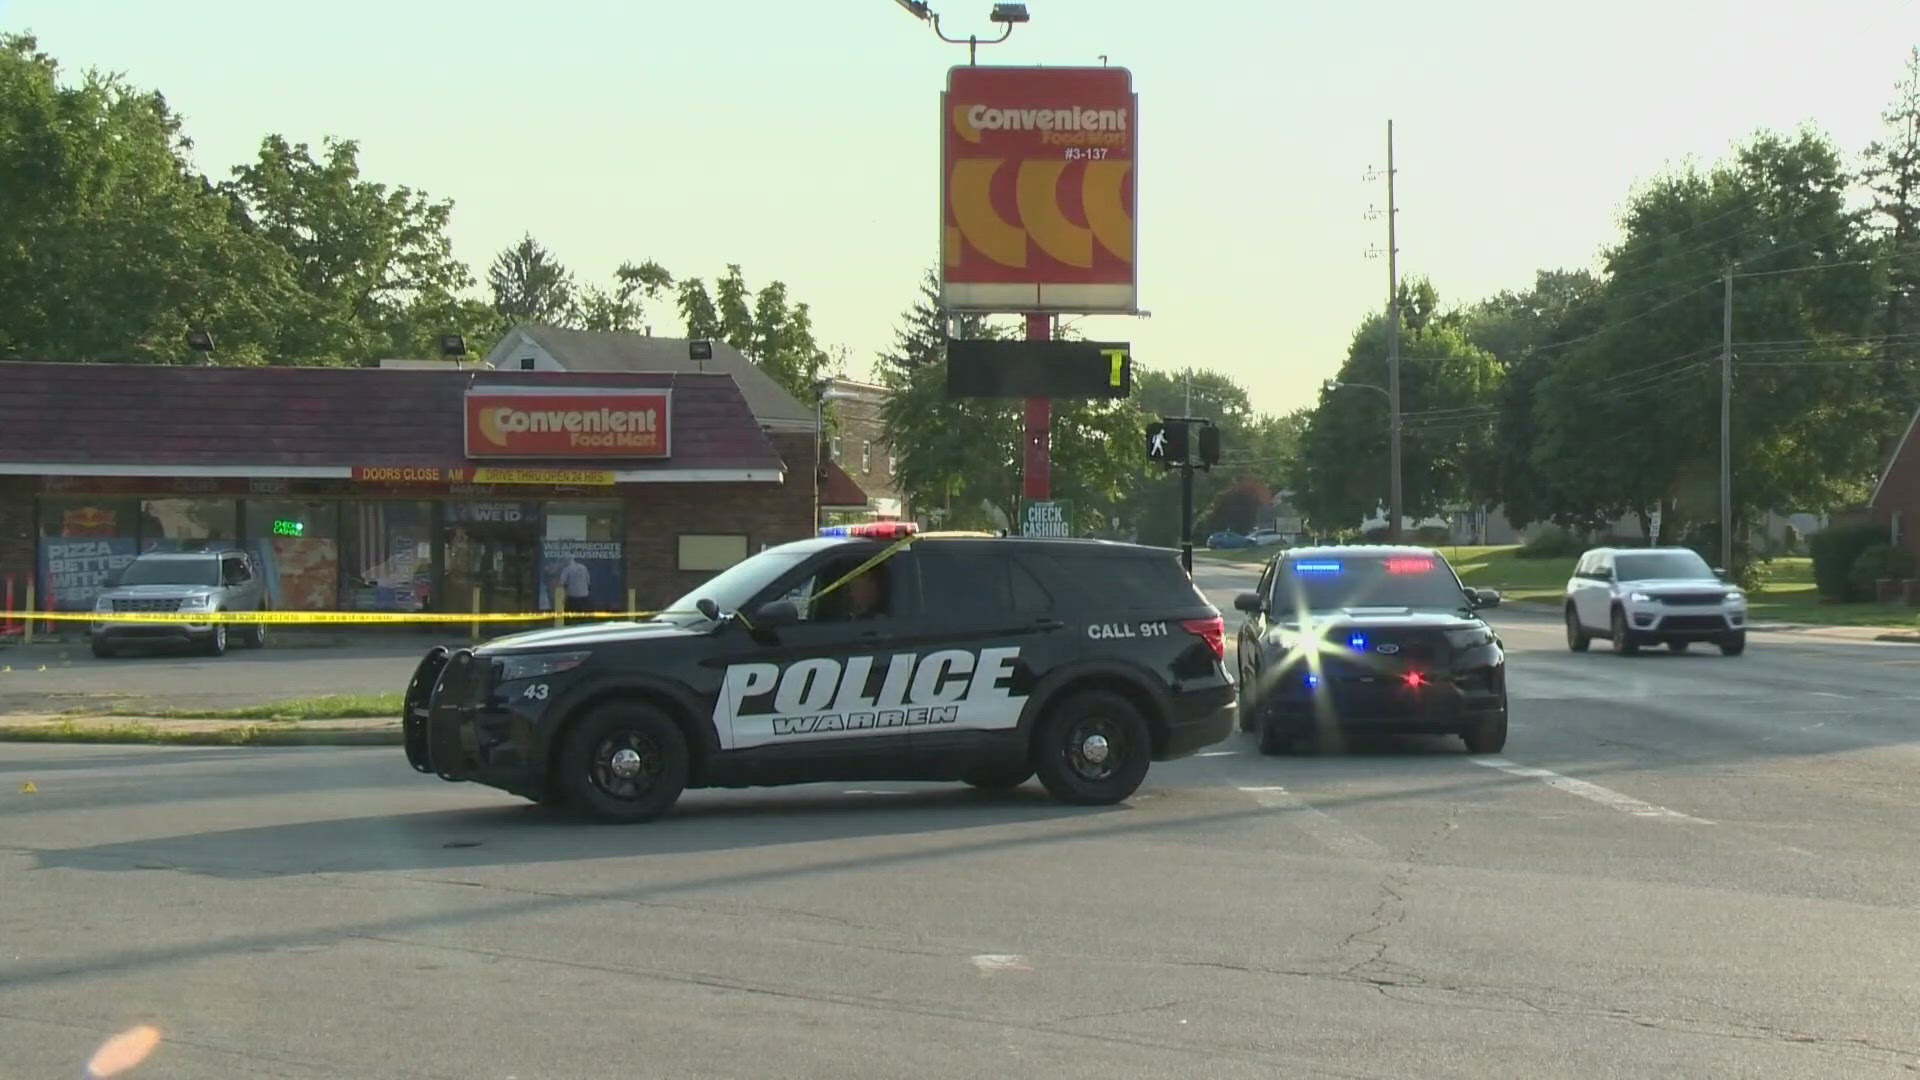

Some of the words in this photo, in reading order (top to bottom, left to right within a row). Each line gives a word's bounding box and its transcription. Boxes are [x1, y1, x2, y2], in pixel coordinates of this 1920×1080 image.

[968, 104, 1127, 131] Convenient
[1041, 131, 1083, 144] Food
[1087, 131, 1126, 145] Mart
[1065, 147, 1108, 160] #3-137
[495, 407, 656, 432] Convenient
[570, 432, 614, 447] Food
[617, 433, 656, 447] Mart
[363, 468, 401, 480] DOORS
[404, 468, 439, 481] CLOSE
[448, 468, 463, 481] AM
[486, 469, 514, 480] DRIVE
[517, 470, 542, 481] THRU
[544, 471, 569, 481] OPEN
[571, 471, 582, 481] 24
[585, 471, 603, 482] HRS
[1028, 506, 1063, 522] CHECK
[1023, 522, 1069, 538] CASHING
[48, 541, 112, 559] PIZZA
[544, 542, 560, 550] WE
[53, 571, 109, 587] WITH
[1088, 622, 1136, 640] CALL
[1139, 620, 1169, 637] 911
[737, 646, 1021, 716] POLICE
[523, 683, 550, 700] 43
[772, 705, 959, 736] WARREN
